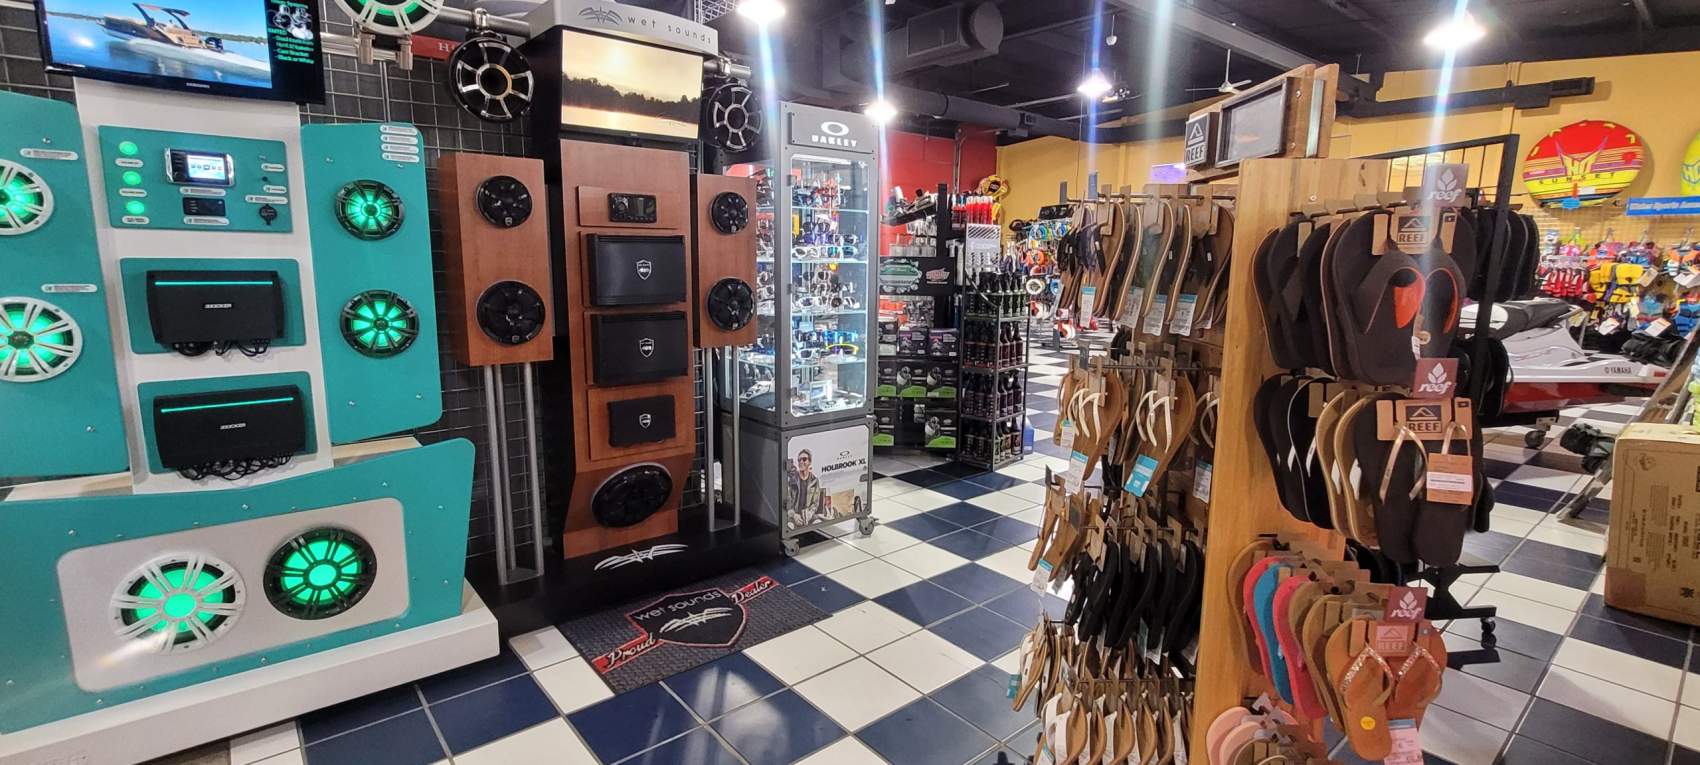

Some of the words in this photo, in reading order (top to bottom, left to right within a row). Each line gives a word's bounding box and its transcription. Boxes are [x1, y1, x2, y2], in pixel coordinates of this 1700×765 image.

[628, 16, 656, 29] wet
[668, 25, 711, 44] sounds
[811, 134, 857, 147] OAKLEY
[1186, 146, 1204, 161] REEF
[1427, 188, 1463, 203] reef
[1399, 233, 1425, 242] REEF
[1418, 381, 1452, 395] reef
[1408, 422, 1440, 432] REEF
[821, 460, 857, 473] HOLBROOK
[634, 607, 664, 622] wet
[667, 589, 723, 612] sounds
[1391, 607, 1422, 620] reef
[607, 632, 656, 668] Proud
[730, 579, 771, 604] Dealer
